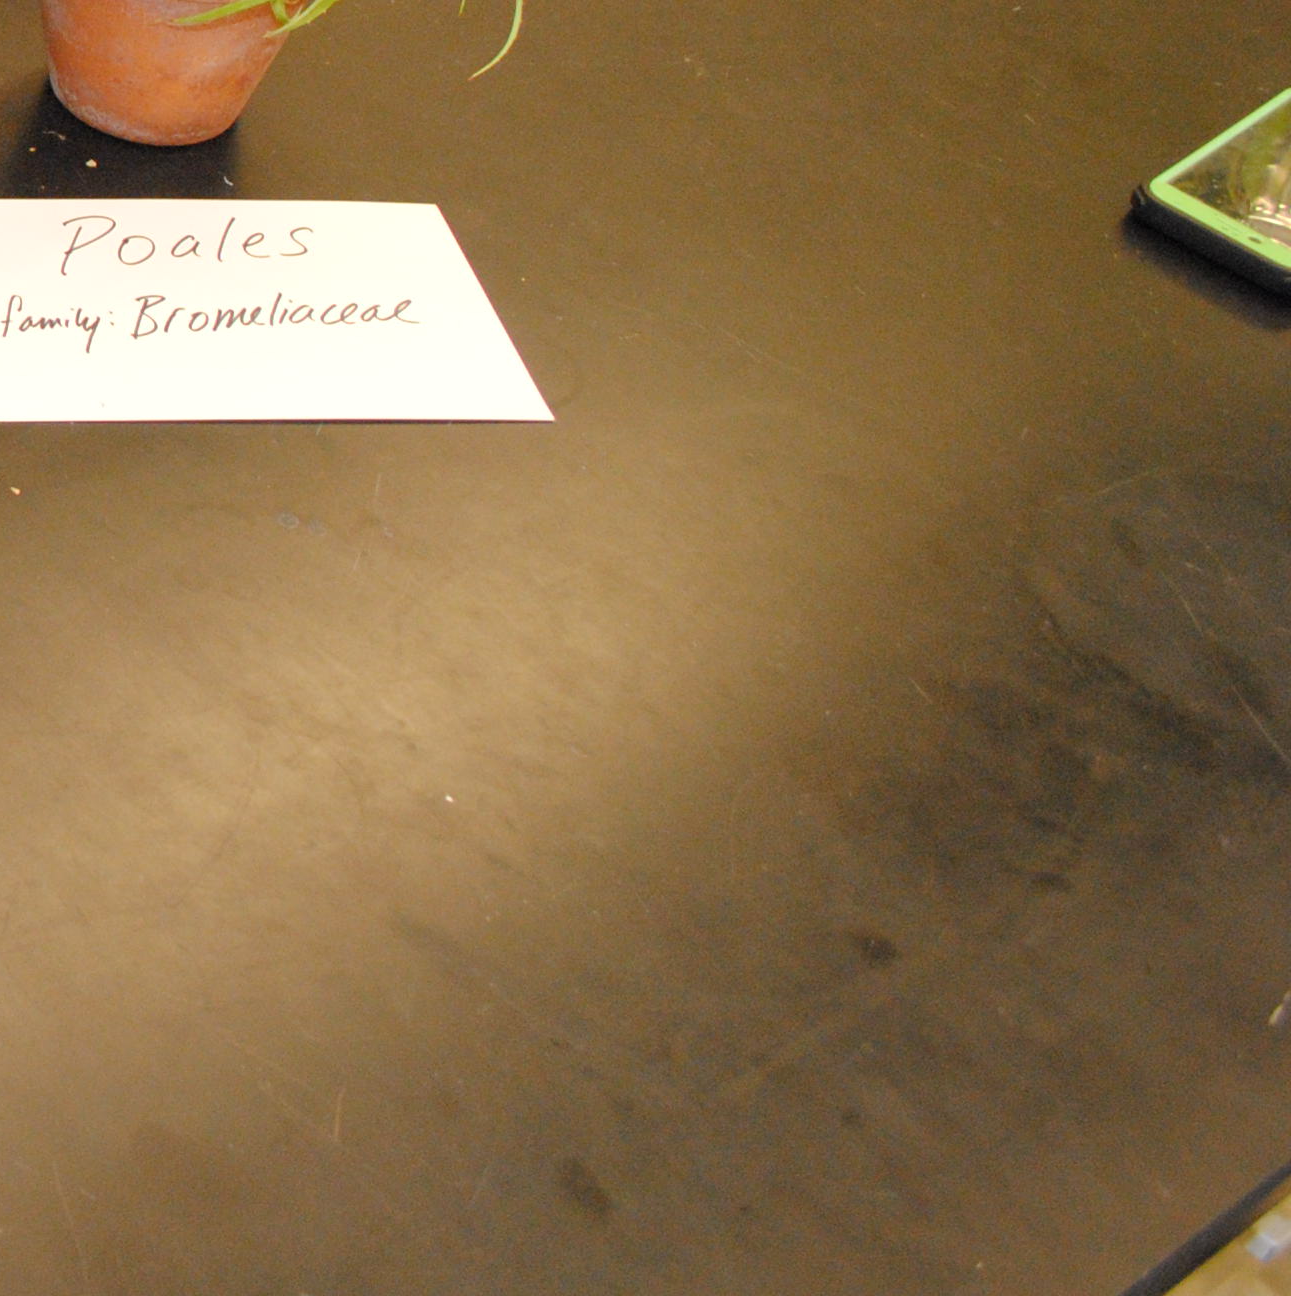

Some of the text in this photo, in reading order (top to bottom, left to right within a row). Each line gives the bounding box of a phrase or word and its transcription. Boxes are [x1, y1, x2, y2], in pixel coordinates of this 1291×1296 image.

[61, 216, 313, 276] Poales
[2, 292, 420, 354] family: Bromeliaceae
